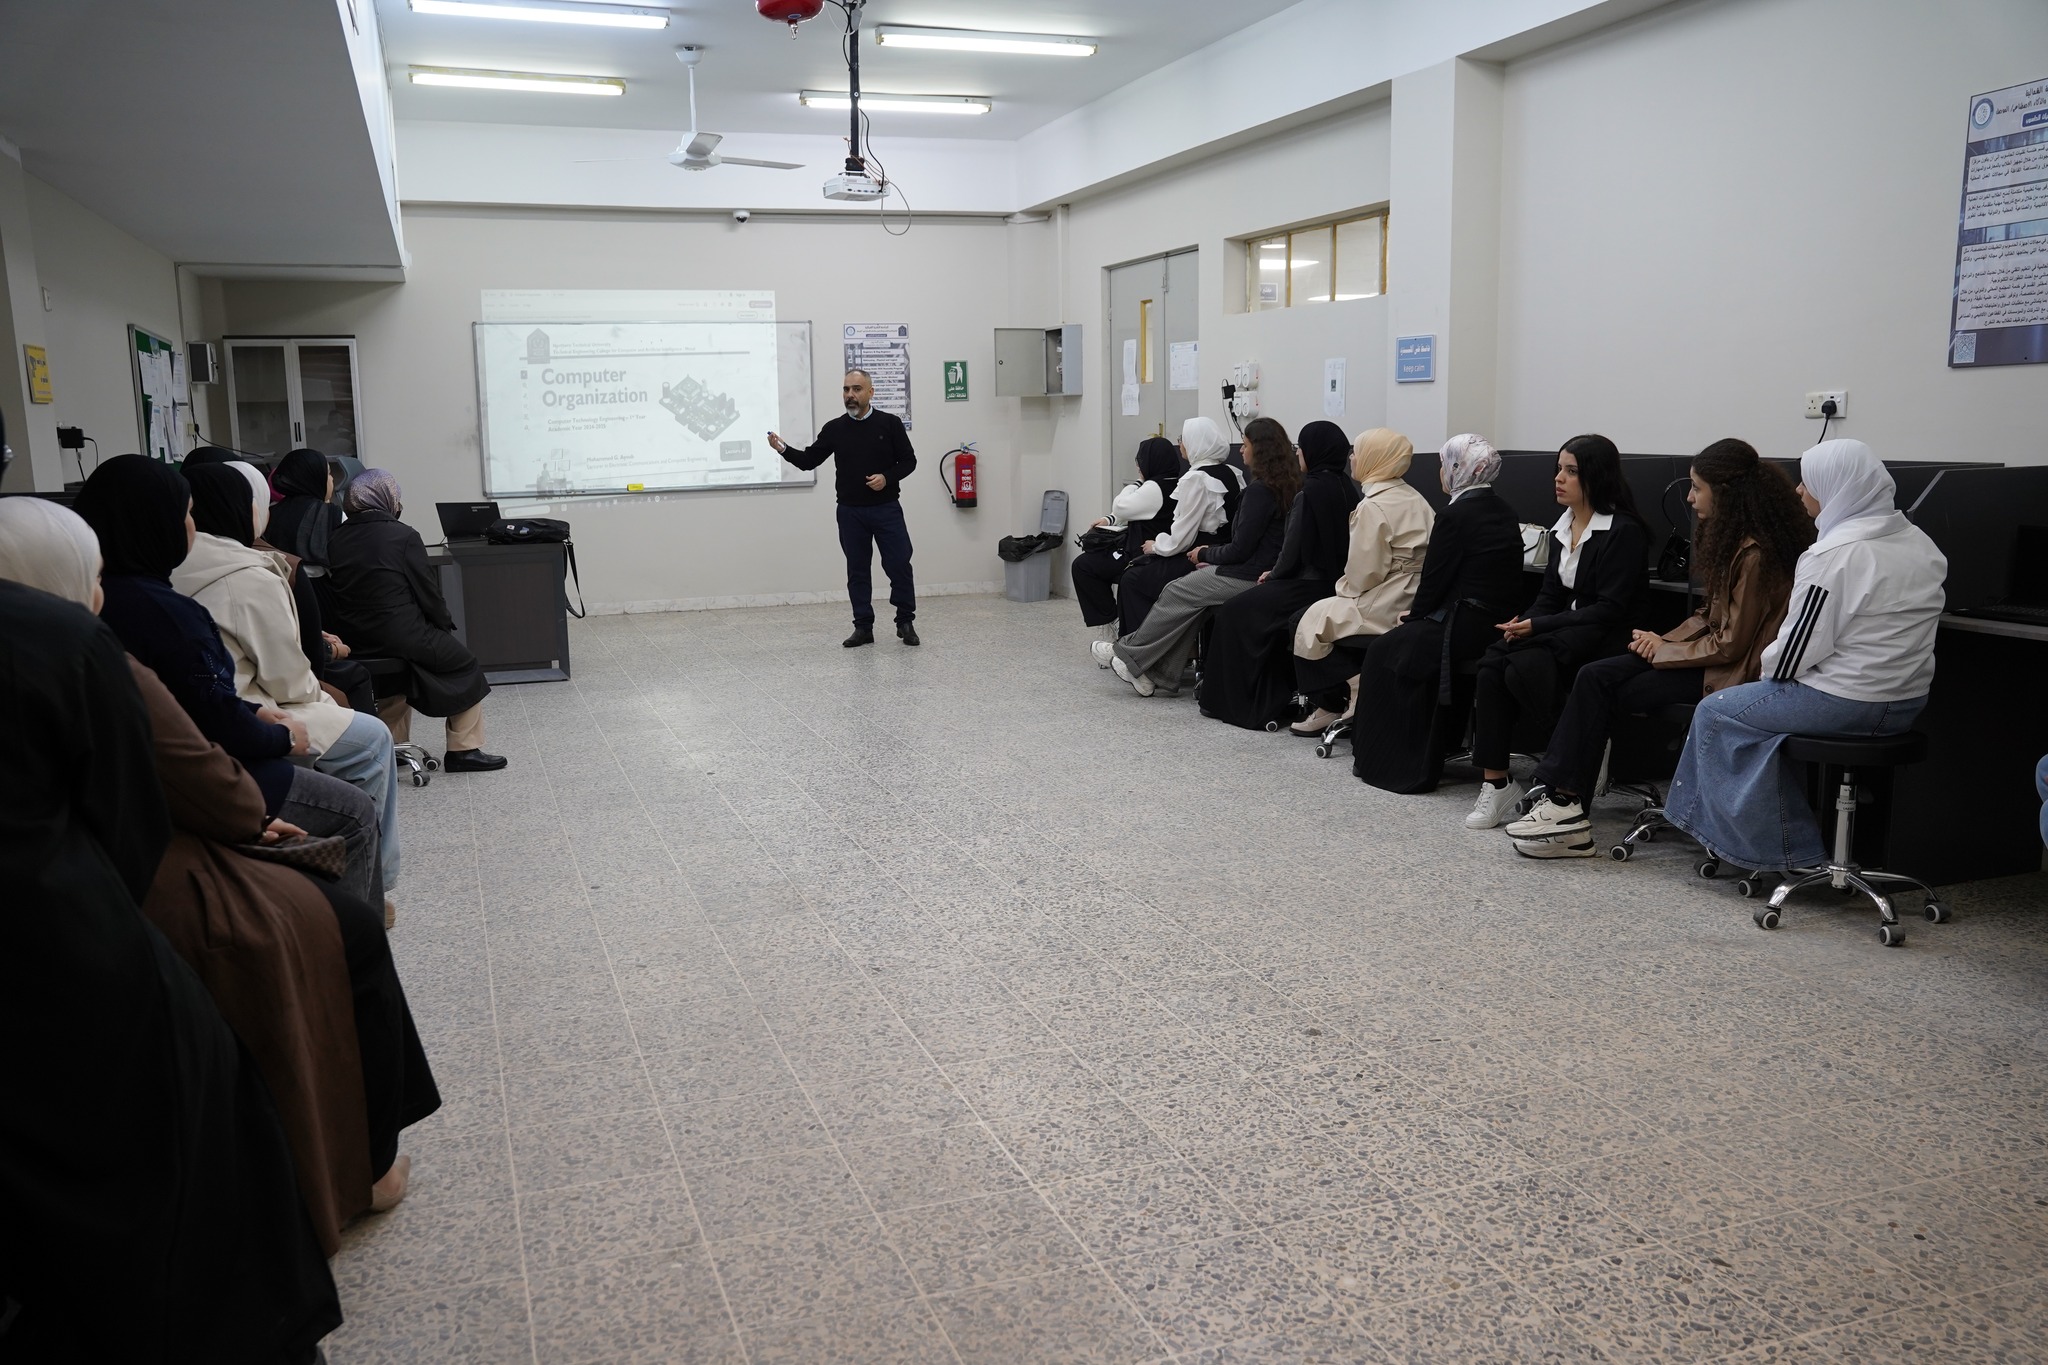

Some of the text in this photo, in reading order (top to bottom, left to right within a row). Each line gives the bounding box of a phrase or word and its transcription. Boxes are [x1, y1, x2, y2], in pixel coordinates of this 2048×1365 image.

[1403, 363, 1425, 374] keep calm
[541, 368, 626, 388] Computer
[542, 387, 648, 411] Organization
[599, 415, 626, 423] Engineering
